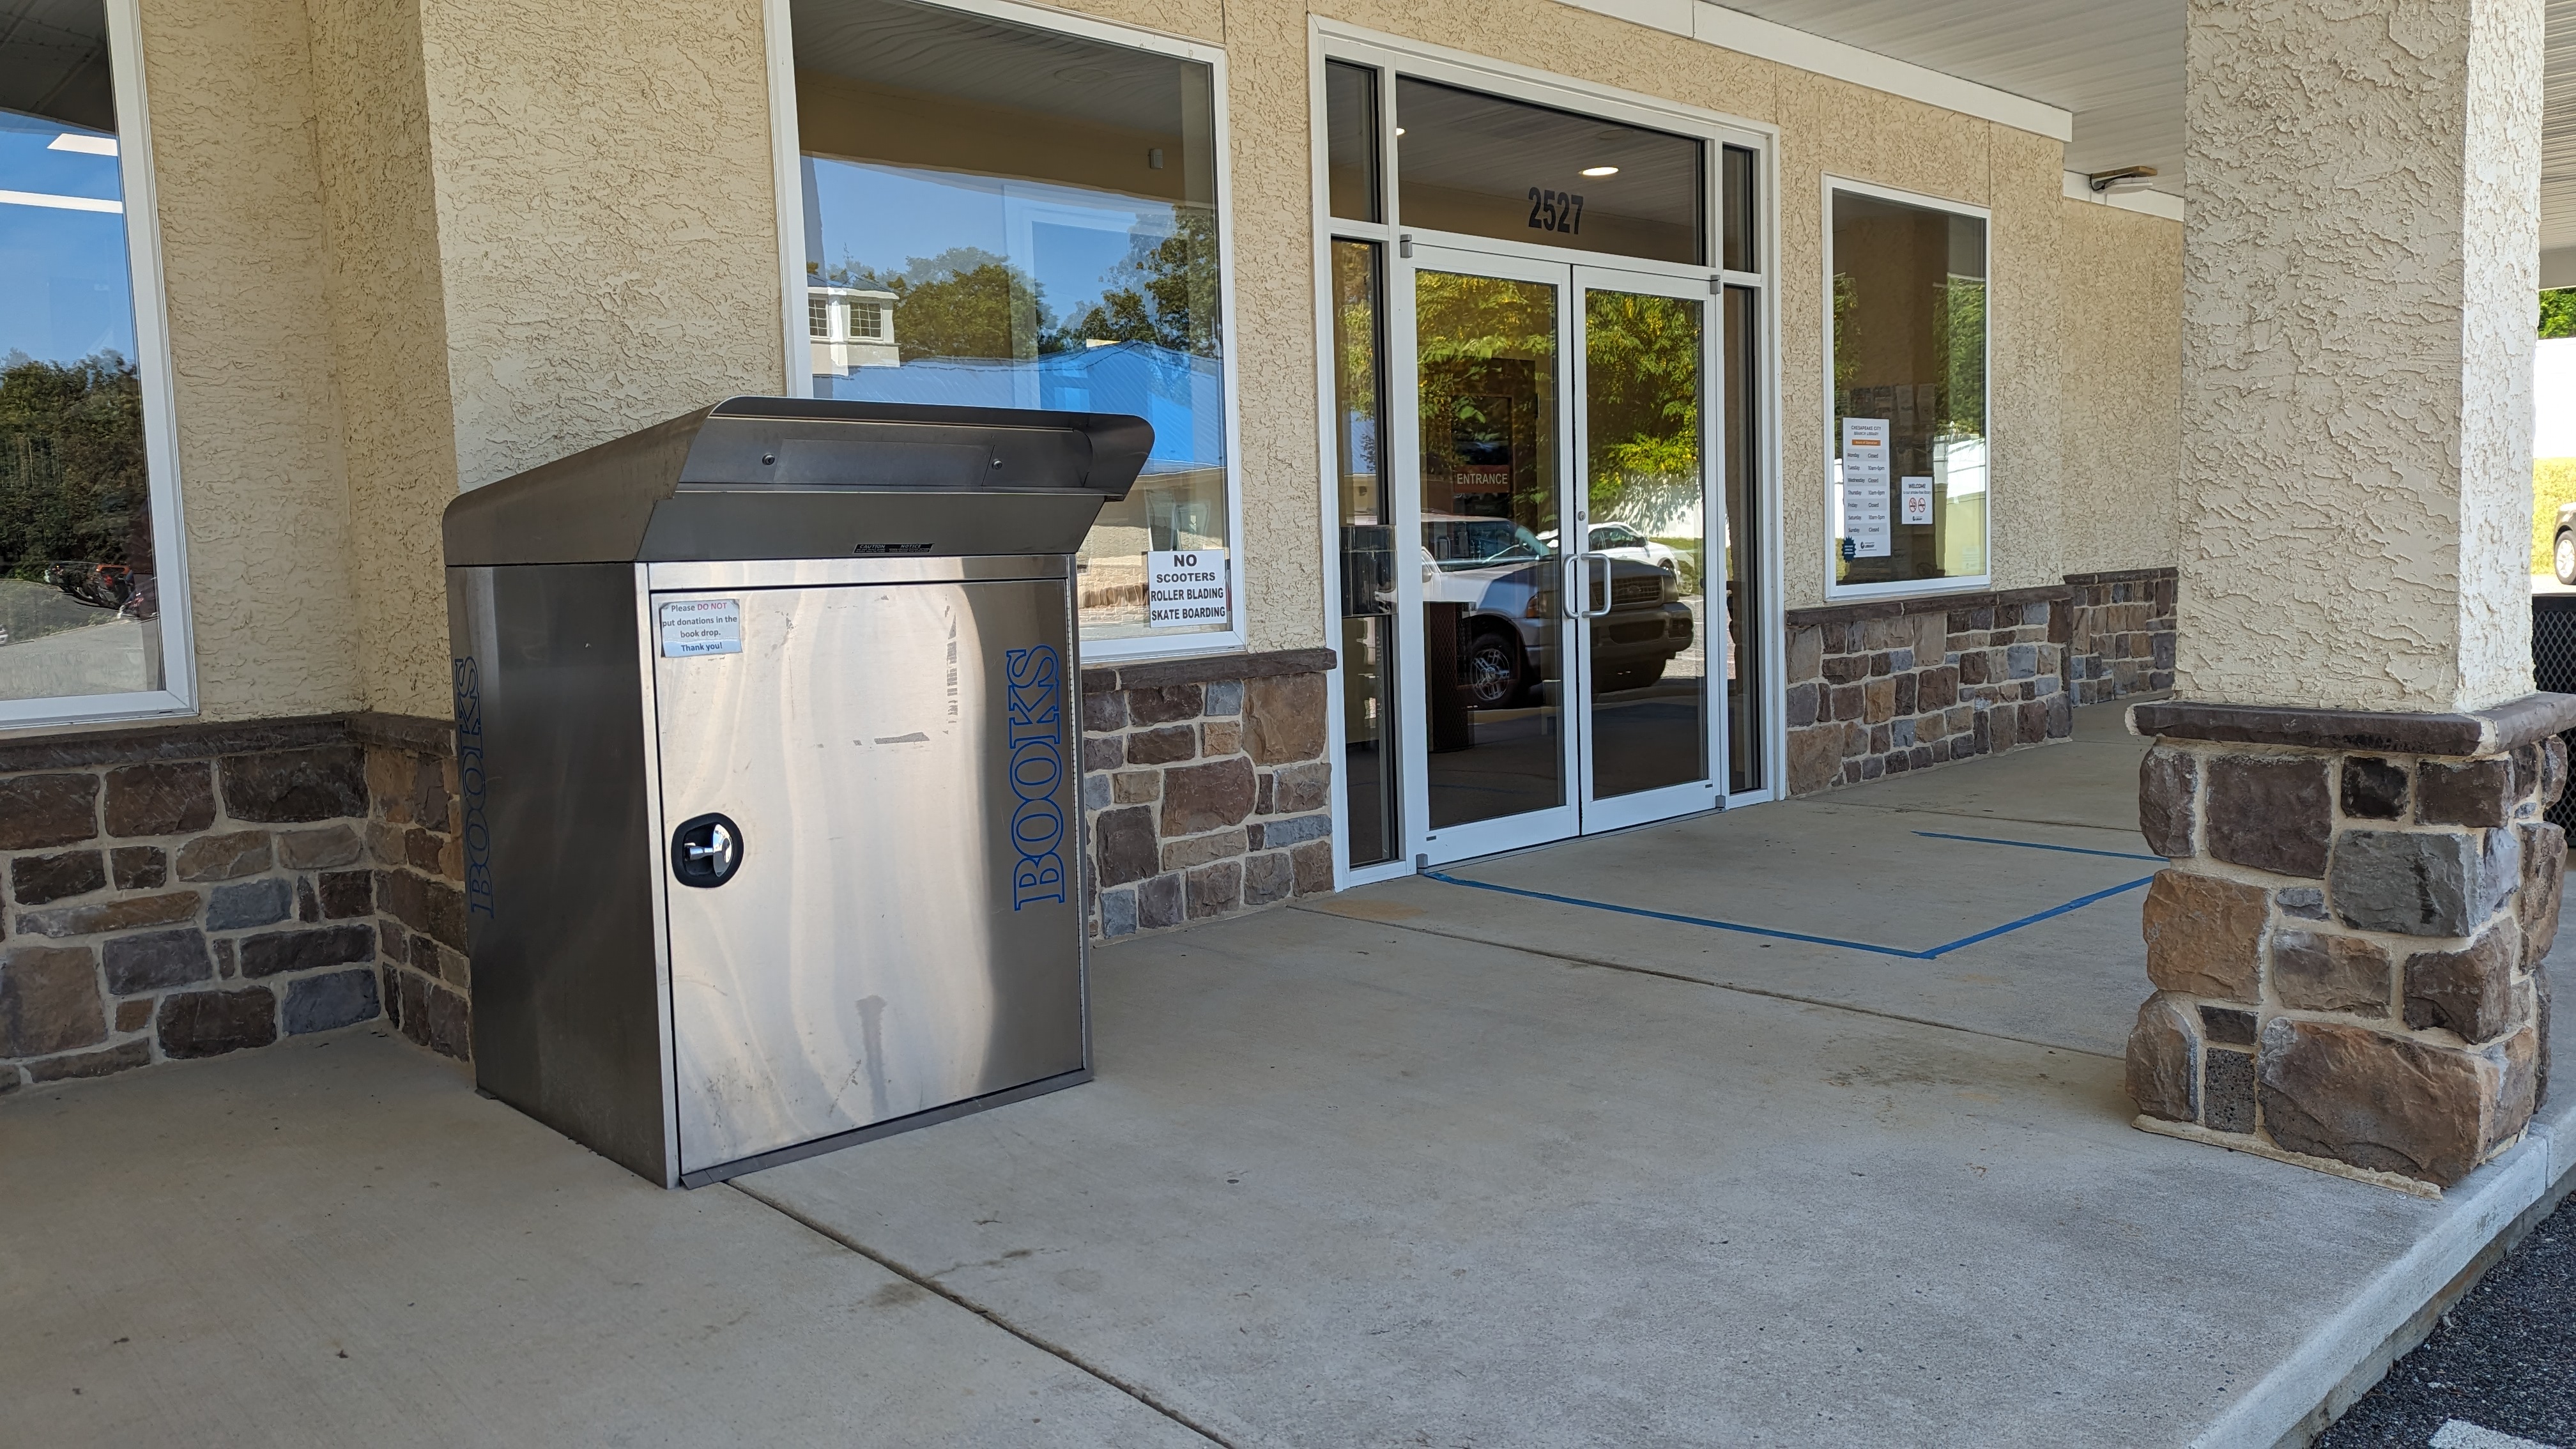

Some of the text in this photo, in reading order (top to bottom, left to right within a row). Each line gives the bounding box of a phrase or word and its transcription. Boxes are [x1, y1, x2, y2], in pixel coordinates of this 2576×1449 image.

[1528, 187, 1584, 234] 2527
[1457, 473, 1508, 484] ENTRANCE
[1174, 554, 1197, 567] NO
[1156, 572, 1216, 583] SCOOTERS
[1151, 587, 1223, 602] ROLLER BLADING
[1151, 606, 1225, 621] SKATE BOARDING
[662, 619, 675, 627] put
[677, 617, 714, 625] donations
[680, 629, 699, 638] book
[681, 642, 723, 652] Thank you!
[1006, 645, 1065, 911] BOOKS
[454, 656, 493, 919] BOOKS
